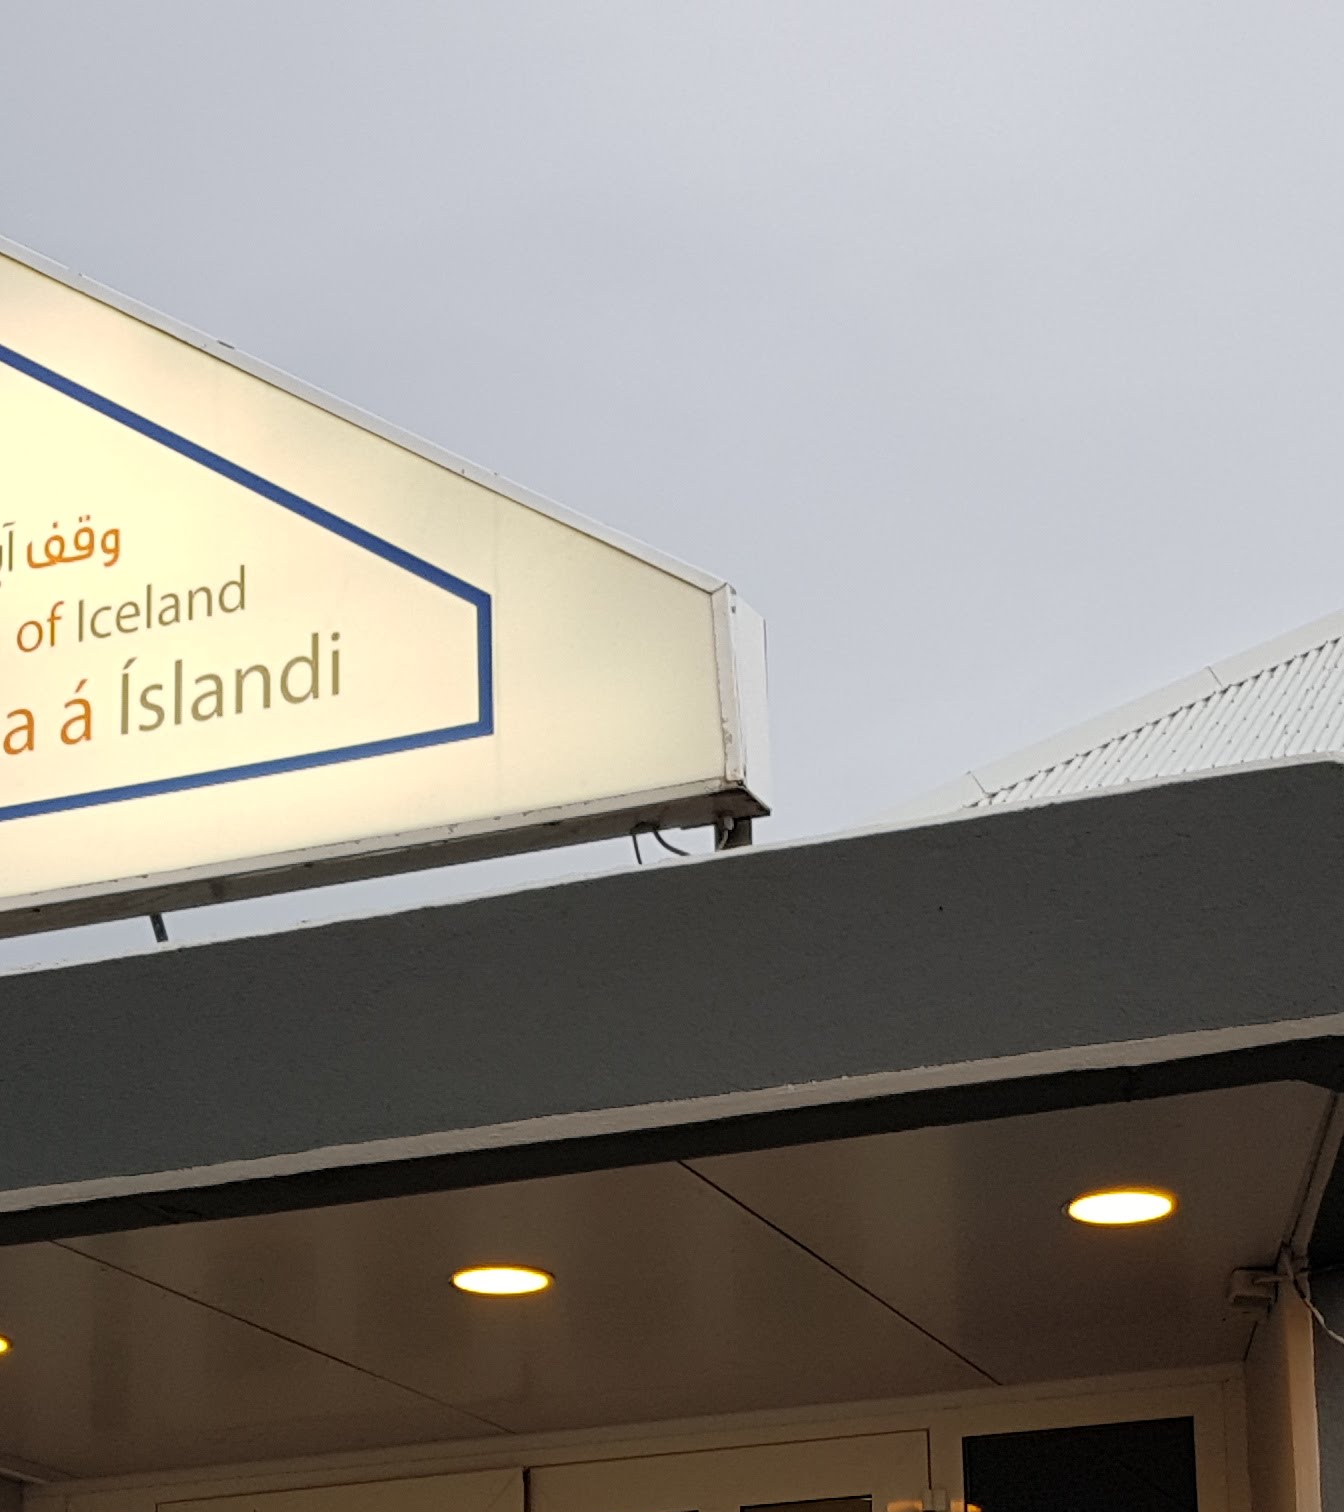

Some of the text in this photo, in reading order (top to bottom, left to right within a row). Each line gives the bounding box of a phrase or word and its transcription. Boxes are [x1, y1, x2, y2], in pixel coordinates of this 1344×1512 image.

[26, 514, 121, 570] وقف
[16, 601, 64, 653] of
[77, 565, 247, 643] Iceland
[59, 678, 93, 746] á
[119, 632, 341, 736] Íslandi
